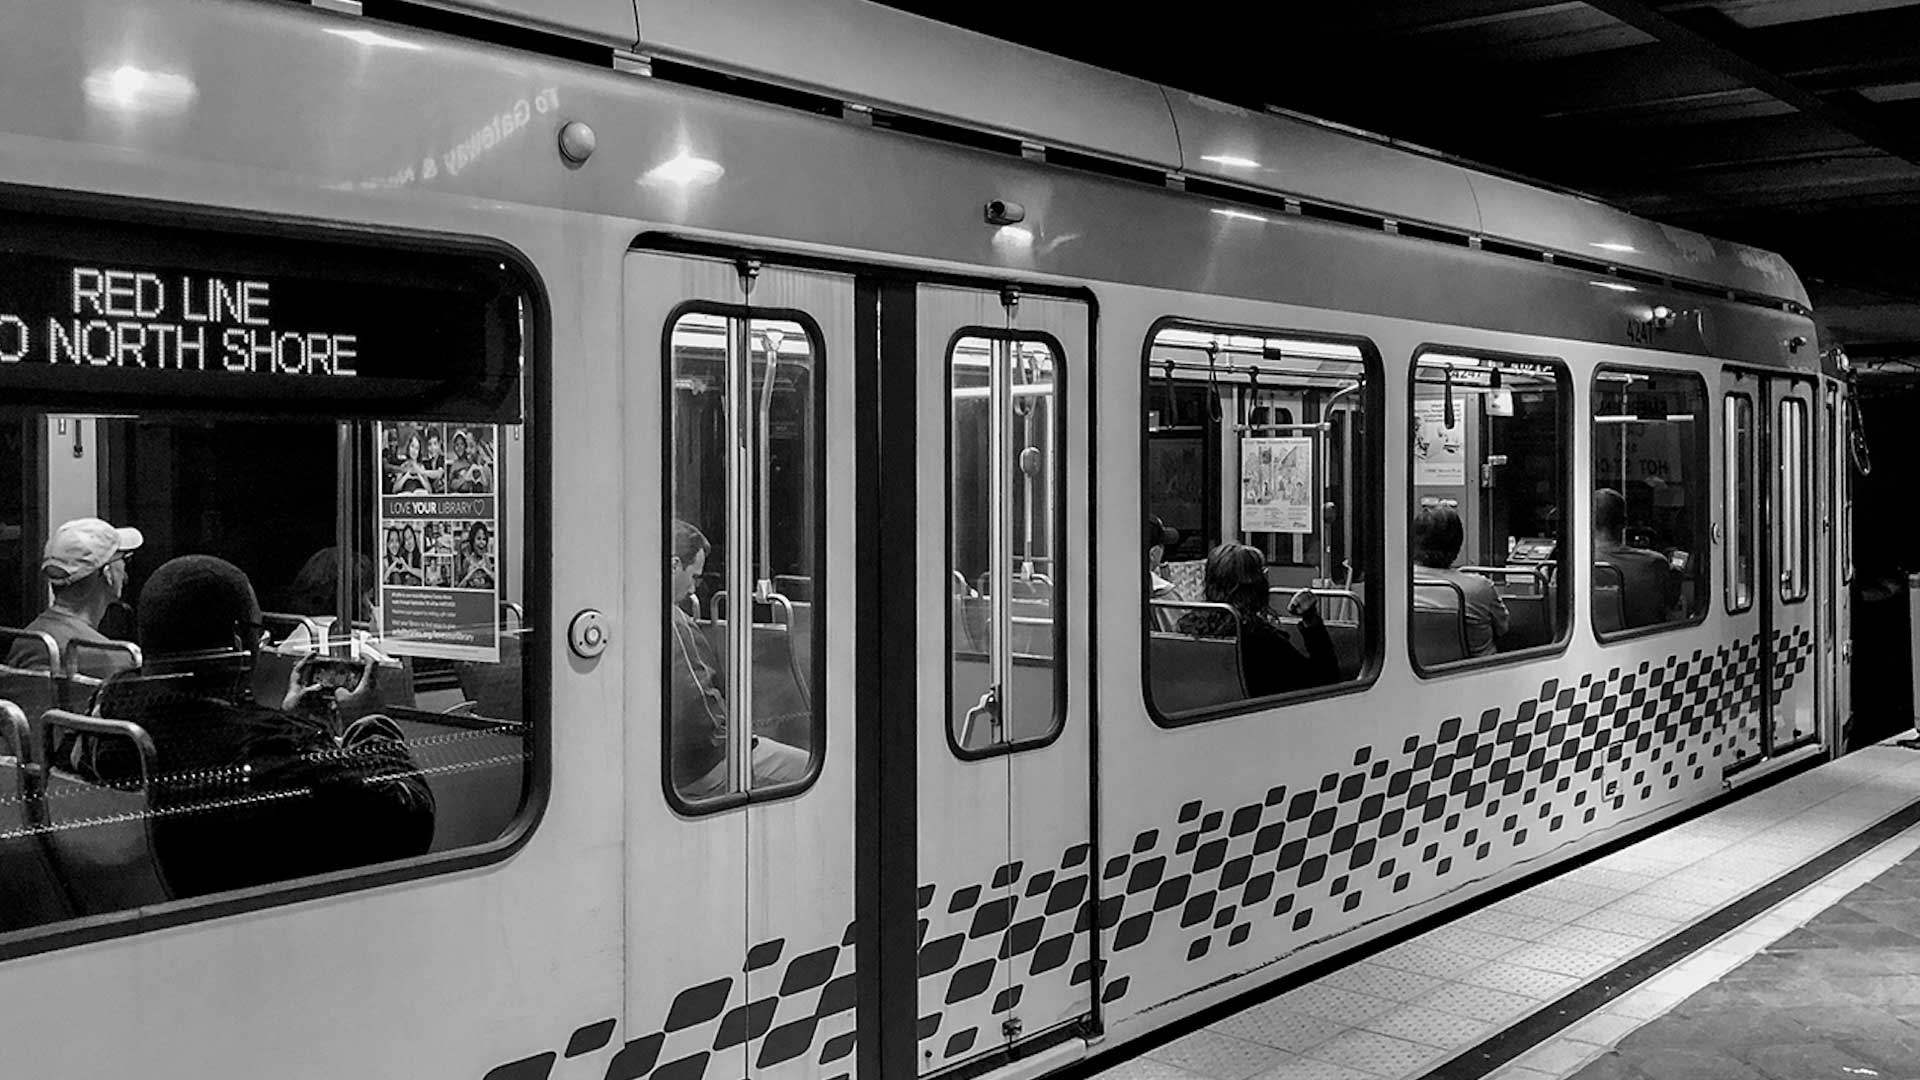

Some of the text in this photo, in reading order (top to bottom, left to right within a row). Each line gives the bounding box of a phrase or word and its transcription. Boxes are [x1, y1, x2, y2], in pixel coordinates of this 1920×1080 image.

[73, 267, 269, 325] RED LINE
[50, 317, 204, 370] NORTH
[223, 328, 357, 376] SHORE
[389, 501, 473, 515] LOVE YOUR LIBRARY
